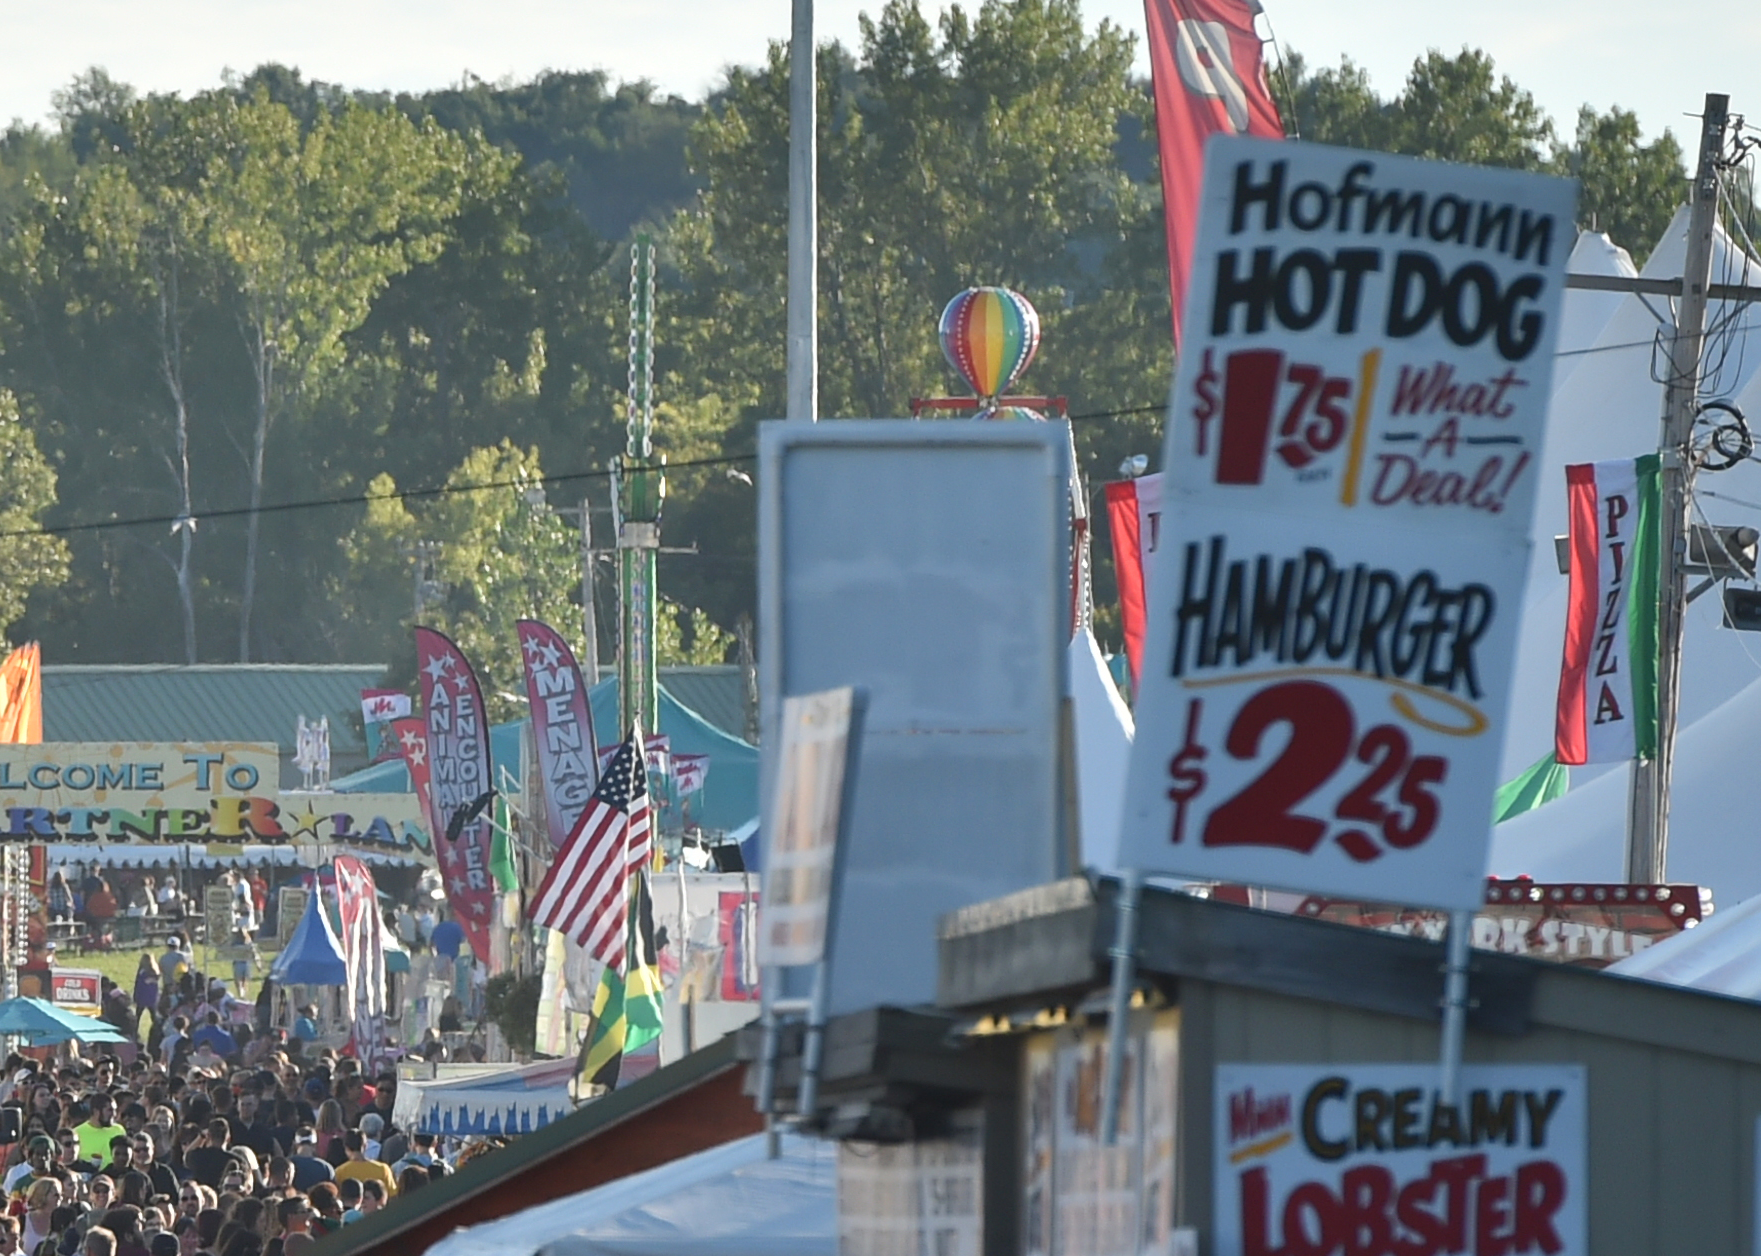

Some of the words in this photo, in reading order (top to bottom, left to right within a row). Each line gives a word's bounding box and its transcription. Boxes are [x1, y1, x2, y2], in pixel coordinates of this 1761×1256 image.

[1228, 159, 1557, 266] Hofmann
[1210, 246, 1382, 337] HOT
[1386, 249, 1547, 362] DOG
[1389, 360, 1529, 419] What
[1421, 417, 1464, 458] A
[1370, 451, 1533, 514] Deal!
[1170, 533, 1496, 699] HAMBURGER
[1594, 494, 1629, 725] PIZZA
[182, 752, 259, 792] TO
[456, 694, 487, 890] ENCOUTER
[329, 812, 440, 857] LAN
[1424, 916, 1531, 954] YRK
[1302, 1076, 1565, 1161] CREAMY
